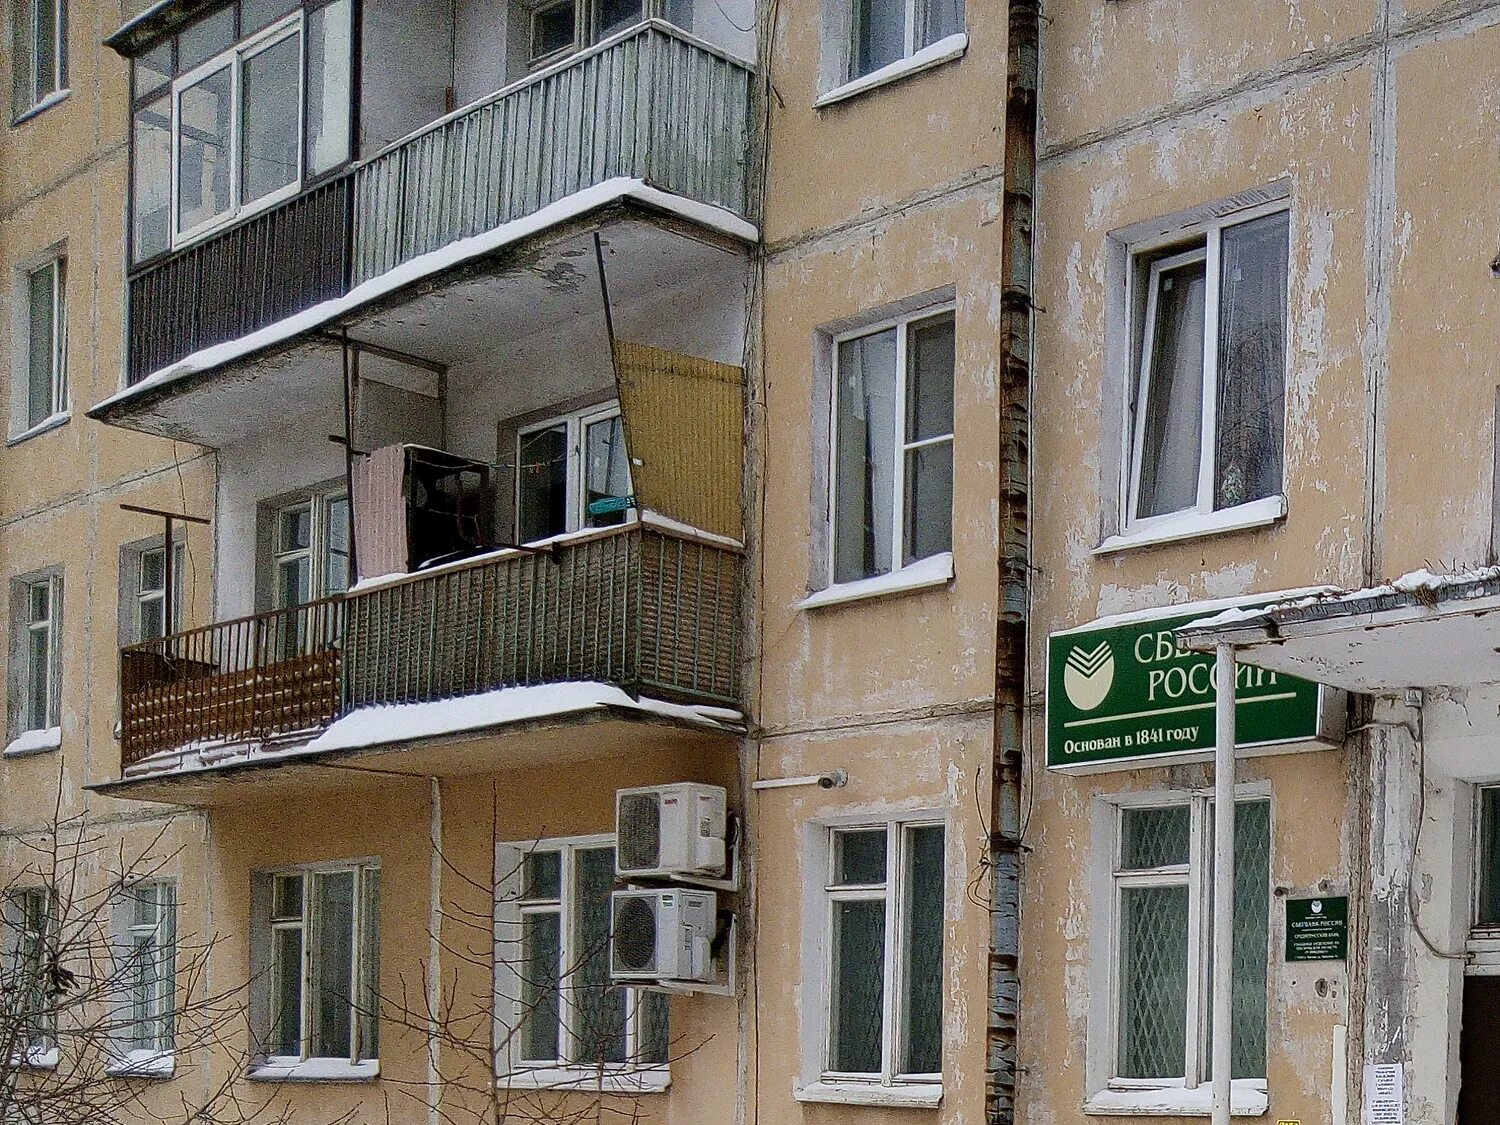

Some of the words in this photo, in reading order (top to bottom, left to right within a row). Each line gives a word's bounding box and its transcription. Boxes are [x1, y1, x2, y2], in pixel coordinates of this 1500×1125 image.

[1064, 736, 1121, 754] Основан
[1124, 735, 1133, 747] в
[1136, 728, 1163, 745] 1841
[1166, 726, 1199, 742] году
